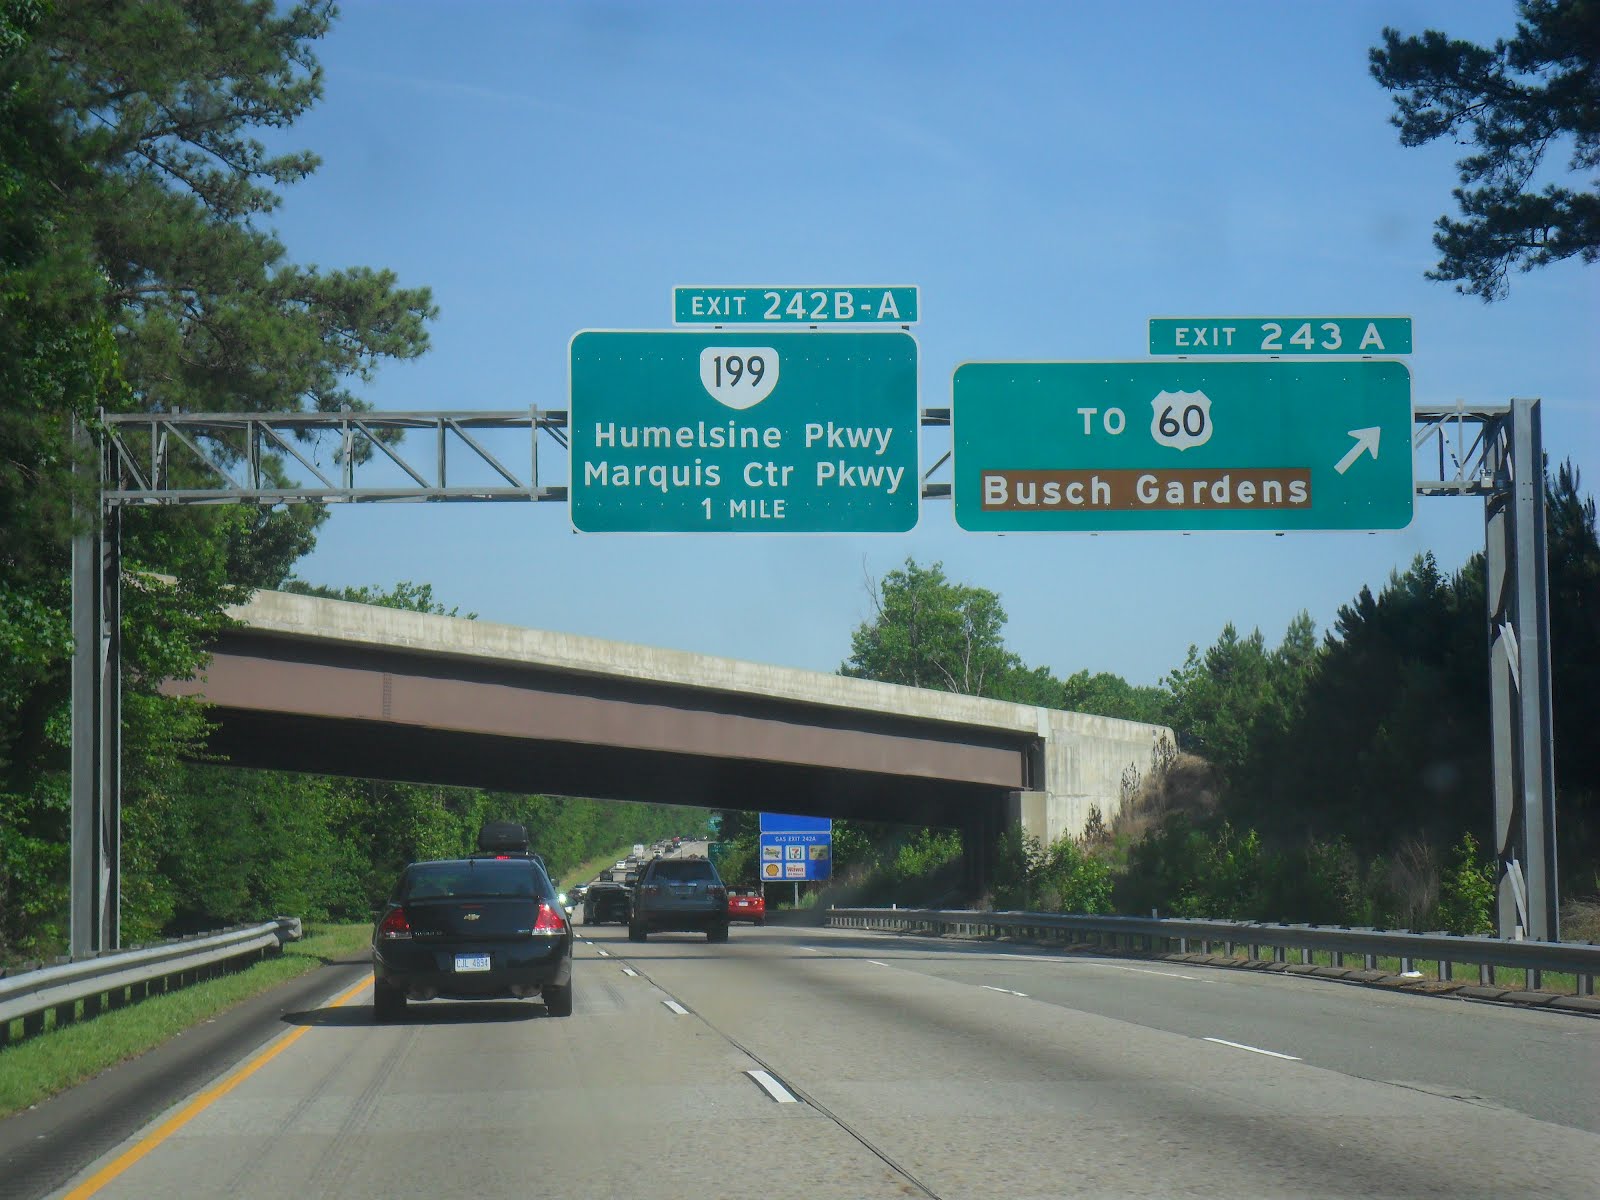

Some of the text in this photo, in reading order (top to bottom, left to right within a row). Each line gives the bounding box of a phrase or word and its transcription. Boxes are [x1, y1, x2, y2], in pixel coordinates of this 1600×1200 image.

[692, 291, 900, 319] EXIT 242B-A
[1175, 323, 1385, 350] EXIT 243 A
[713, 355, 765, 387] 199
[1077, 405, 1205, 437] TO 60
[595, 420, 892, 455] Humelsine Pkwy
[584, 458, 905, 494] Marquis Ctr Pkwy
[984, 474, 1308, 504] Busch Gardens
[701, 498, 785, 519] 1 MILE
